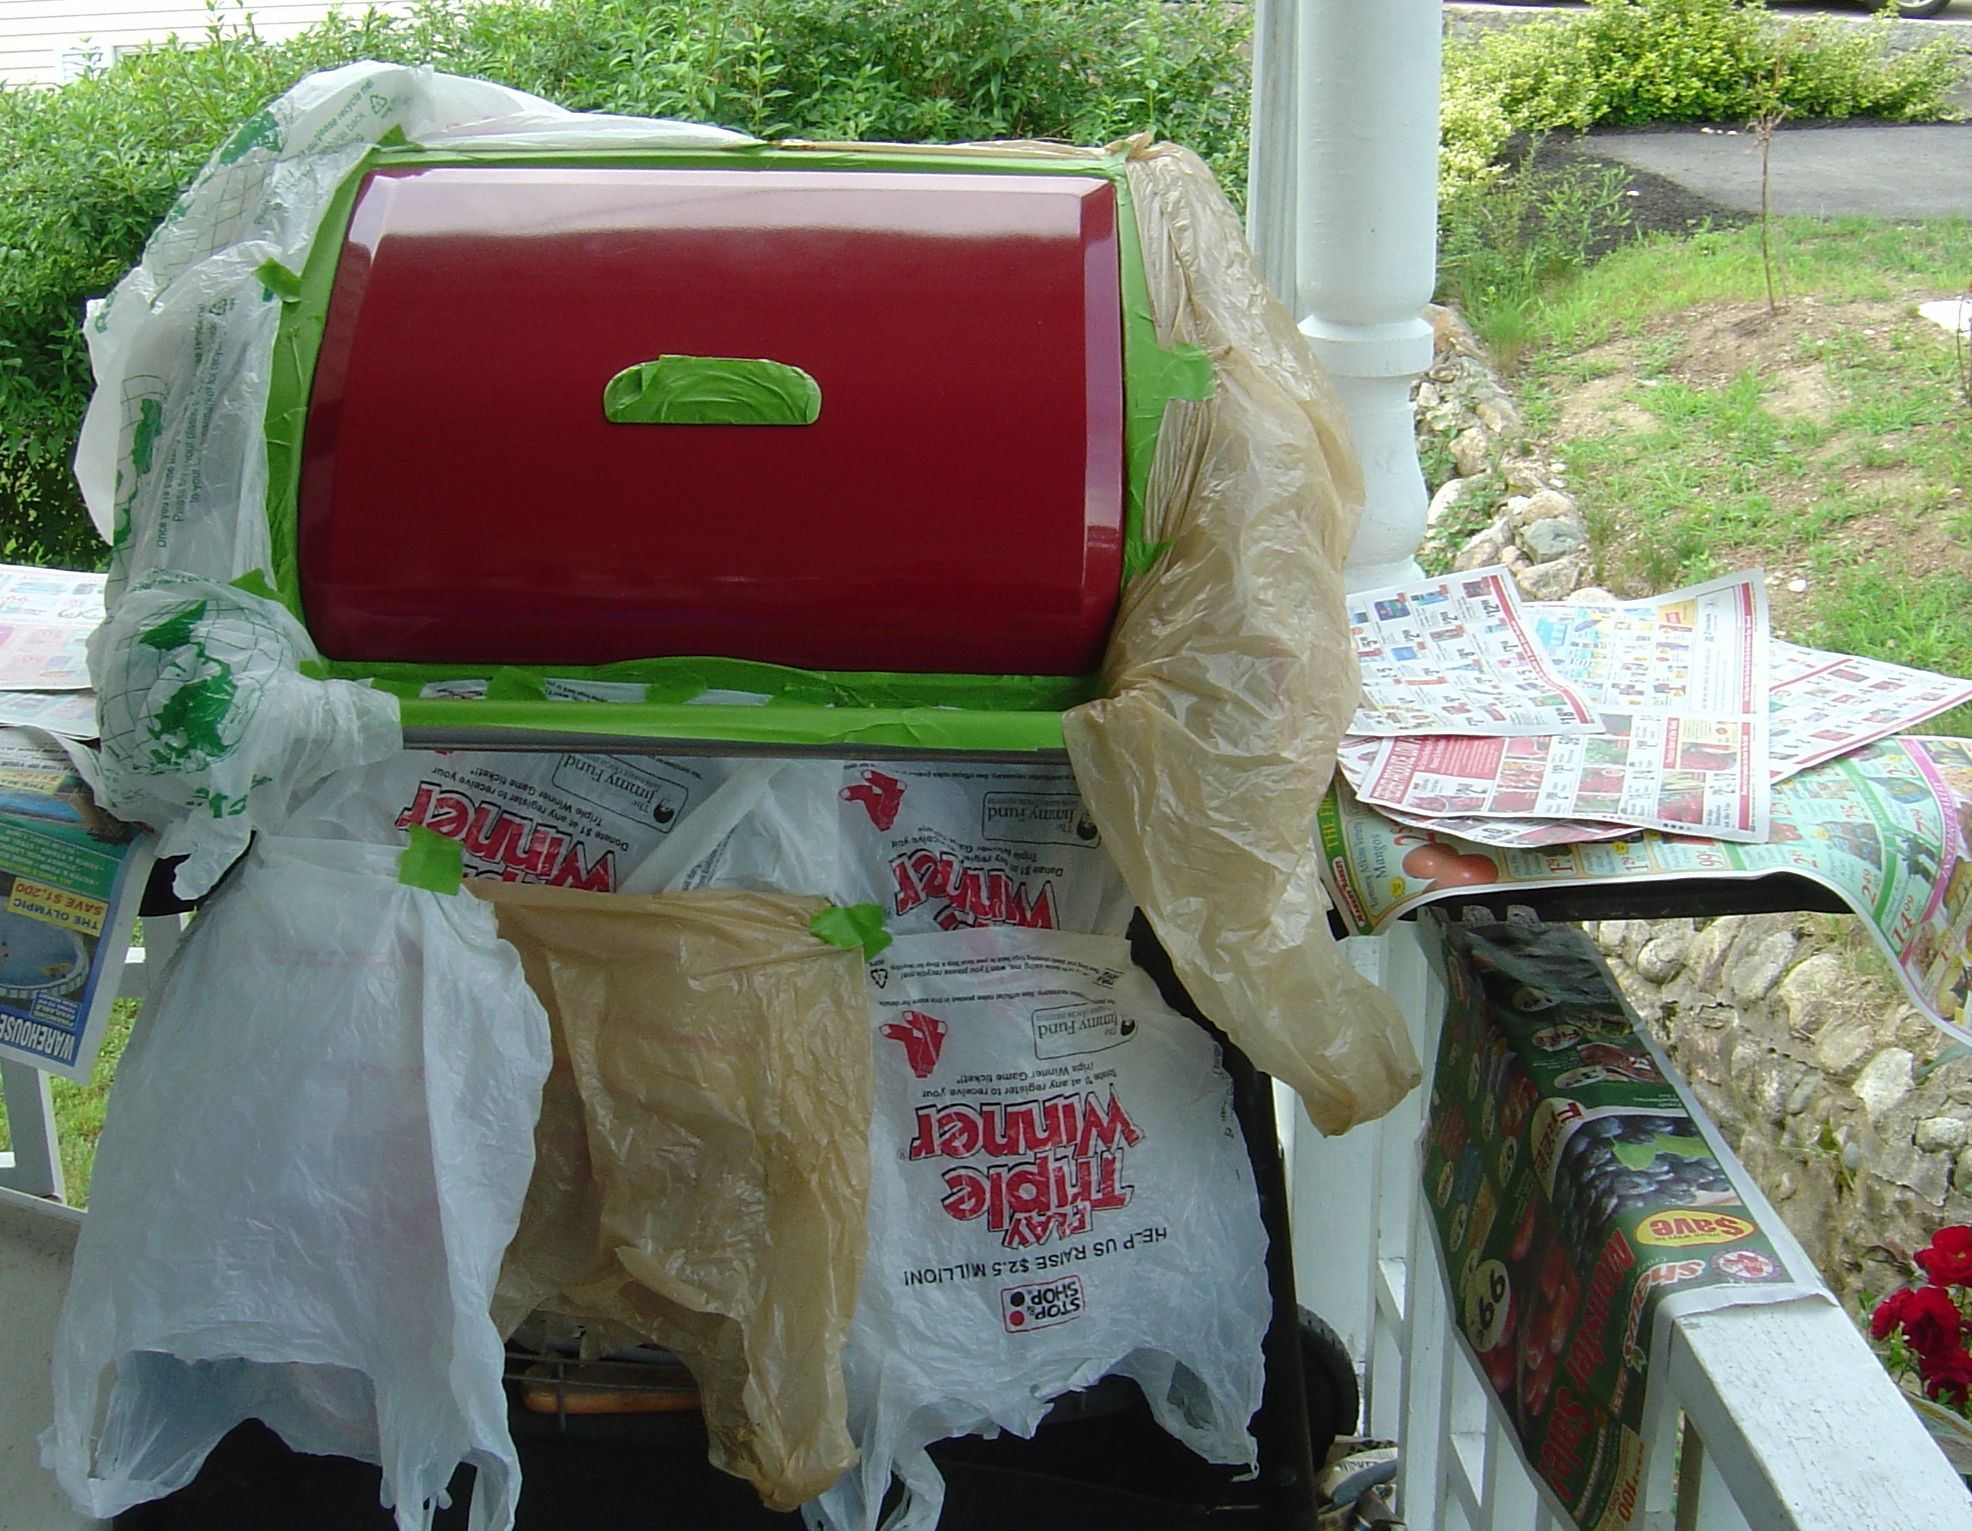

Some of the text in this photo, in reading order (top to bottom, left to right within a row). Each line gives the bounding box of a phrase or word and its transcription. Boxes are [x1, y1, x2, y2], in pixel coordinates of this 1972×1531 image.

[431, 766, 455, 781] your
[562, 755, 602, 785] Fund
[458, 775, 495, 795] receive
[496, 788, 507, 799] to
[508, 778, 535, 795] Game
[602, 771, 655, 804] Jimmy
[508, 791, 546, 815] register
[537, 790, 571, 813] Winner
[548, 808, 566, 824] any
[574, 806, 602, 826] Triple
[987, 807, 1024, 821] Fund
[394, 780, 615, 892] Winner
[579, 825, 592, 838] $1
[593, 831, 628, 851] Donate
[1372, 833, 1386, 878] Mangos
[14, 881, 103, 916] SAVE $1,200
[11, 897, 99, 930] THE OLYMPIC
[0, 1012, 77, 1061] WAREHOUSE
[1037, 1020, 1075, 1038] Fund
[995, 1070, 1027, 1081] Game
[1030, 1065, 1068, 1077] Winner
[922, 1087, 946, 1098] your
[948, 1087, 987, 1098] receive
[1004, 1082, 1045, 1096] register
[1048, 1077, 1067, 1088] any
[909, 1083, 1144, 1160] Winner
[940, 1147, 1133, 1232] Triple
[1001, 1206, 1091, 1249] PLAY
[1092, 1237, 1116, 1256] US
[992, 1257, 1028, 1276] $2.5
[1035, 1244, 1085, 1270] RAISE
[903, 1262, 985, 1285] MILLION!
[1030, 1280, 1078, 1305] SHOP
[1566, 1226, 1635, 1382] Monster
[1538, 1389, 1595, 1502] Sale!
